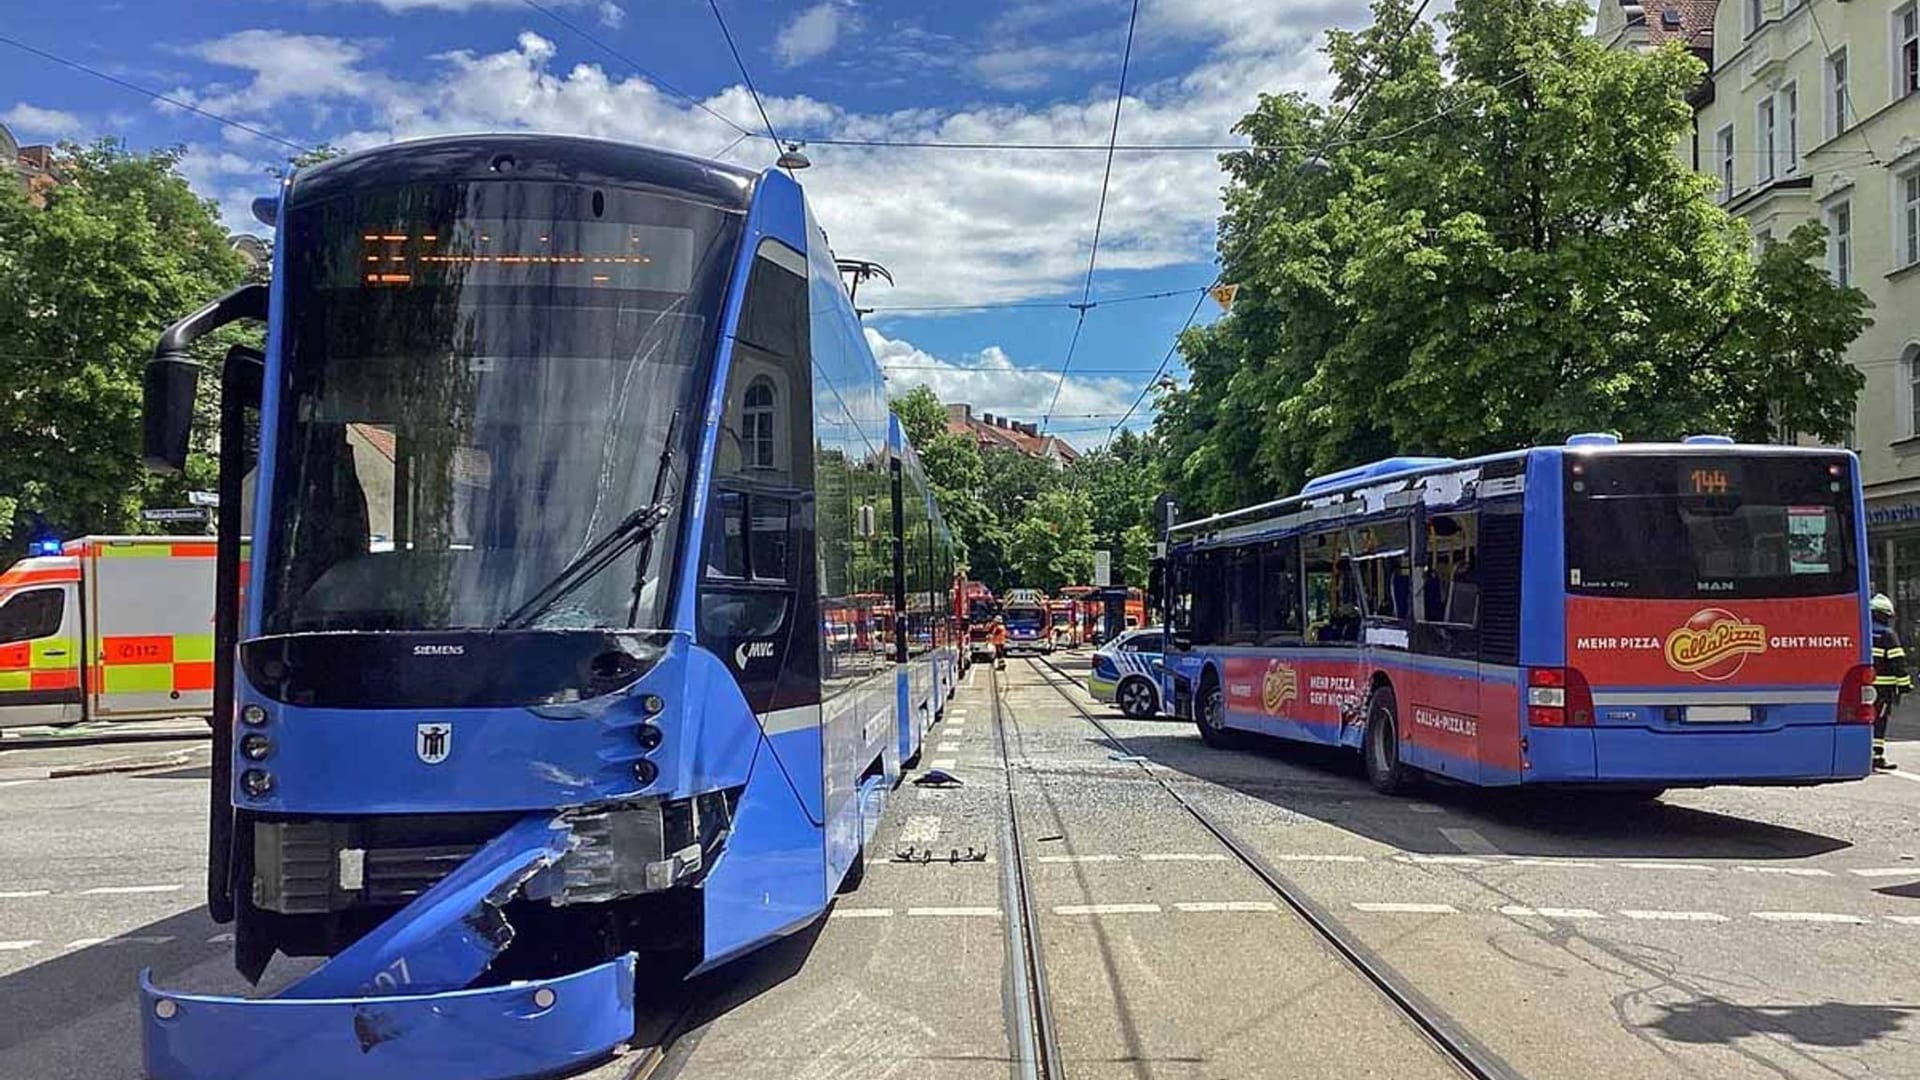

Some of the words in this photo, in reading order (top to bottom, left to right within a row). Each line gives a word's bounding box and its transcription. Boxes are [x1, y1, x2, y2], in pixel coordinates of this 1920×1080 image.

[1691, 470, 1727, 493] 144
[1697, 581, 1734, 591] MAN
[1577, 637, 1617, 649] MEHR
[1619, 637, 1661, 649] PIZZA
[1770, 636, 1807, 649] GEHT
[1808, 636, 1853, 648] NICHT.
[136, 645, 158, 656] 112
[413, 645, 465, 655] SIEMENS
[747, 642, 774, 657] MVG
[1310, 676, 1329, 689] MEHR
[1330, 677, 1355, 690] PIZZA
[1416, 709, 1477, 737] CALL-A-PIZZA.DE
